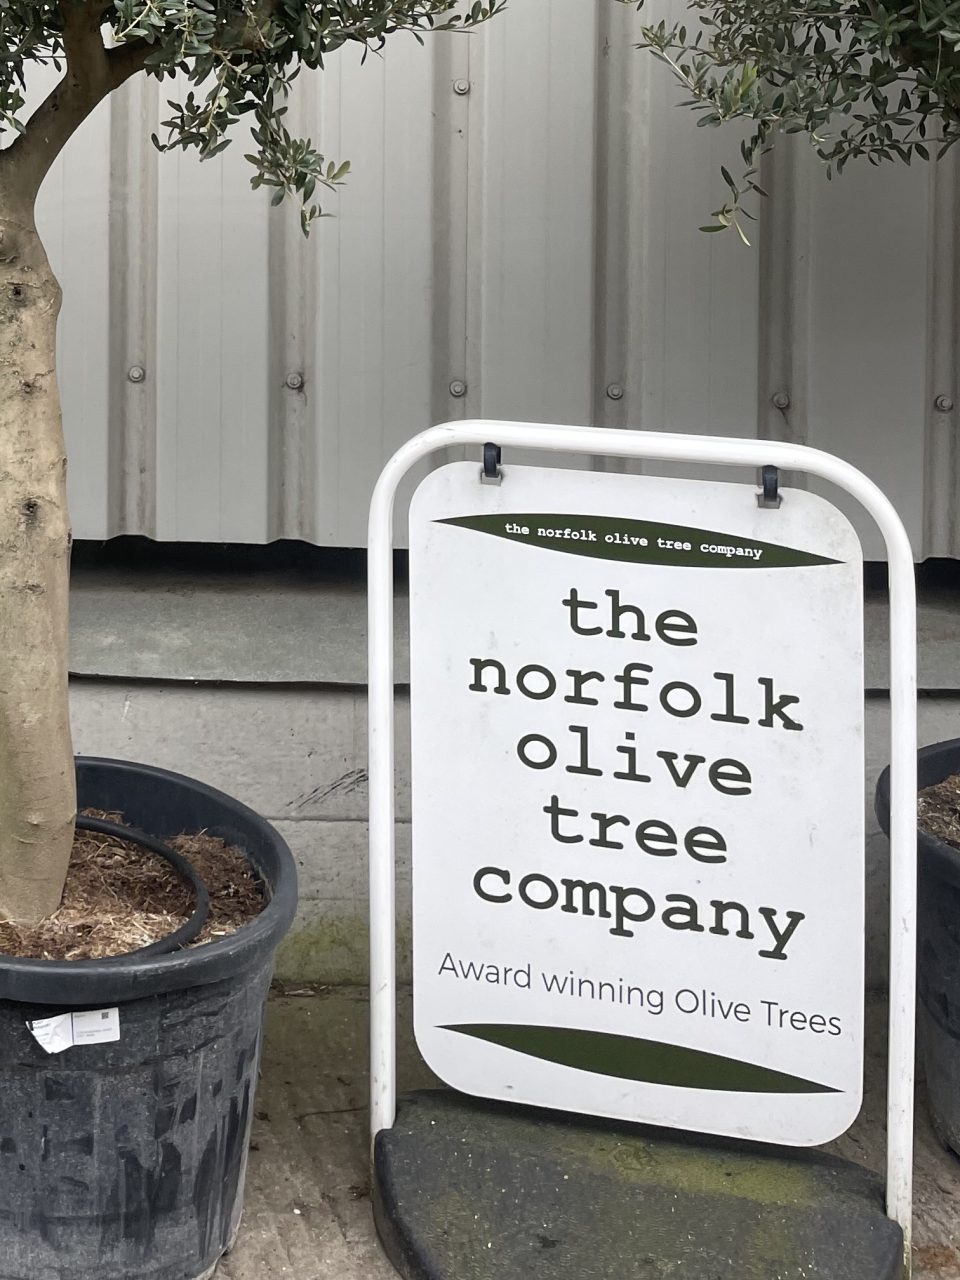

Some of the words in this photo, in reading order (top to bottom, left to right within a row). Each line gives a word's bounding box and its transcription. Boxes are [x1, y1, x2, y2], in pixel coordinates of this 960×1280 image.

[504, 522, 530, 535] the
[537, 527, 597, 542] norfolk
[604, 532, 649, 547] olive
[656, 537, 692, 551] tree
[699, 543, 763, 560] company
[561, 587, 699, 648] the
[468, 656, 804, 732] norfolk
[516, 724, 753, 796] olive
[542, 794, 728, 864] tree
[472, 865, 806, 960] company
[438, 952, 531, 990] Award
[541, 969, 665, 1016] winning
[675, 988, 751, 1023] Olive
[759, 1000, 843, 1037] Trees
